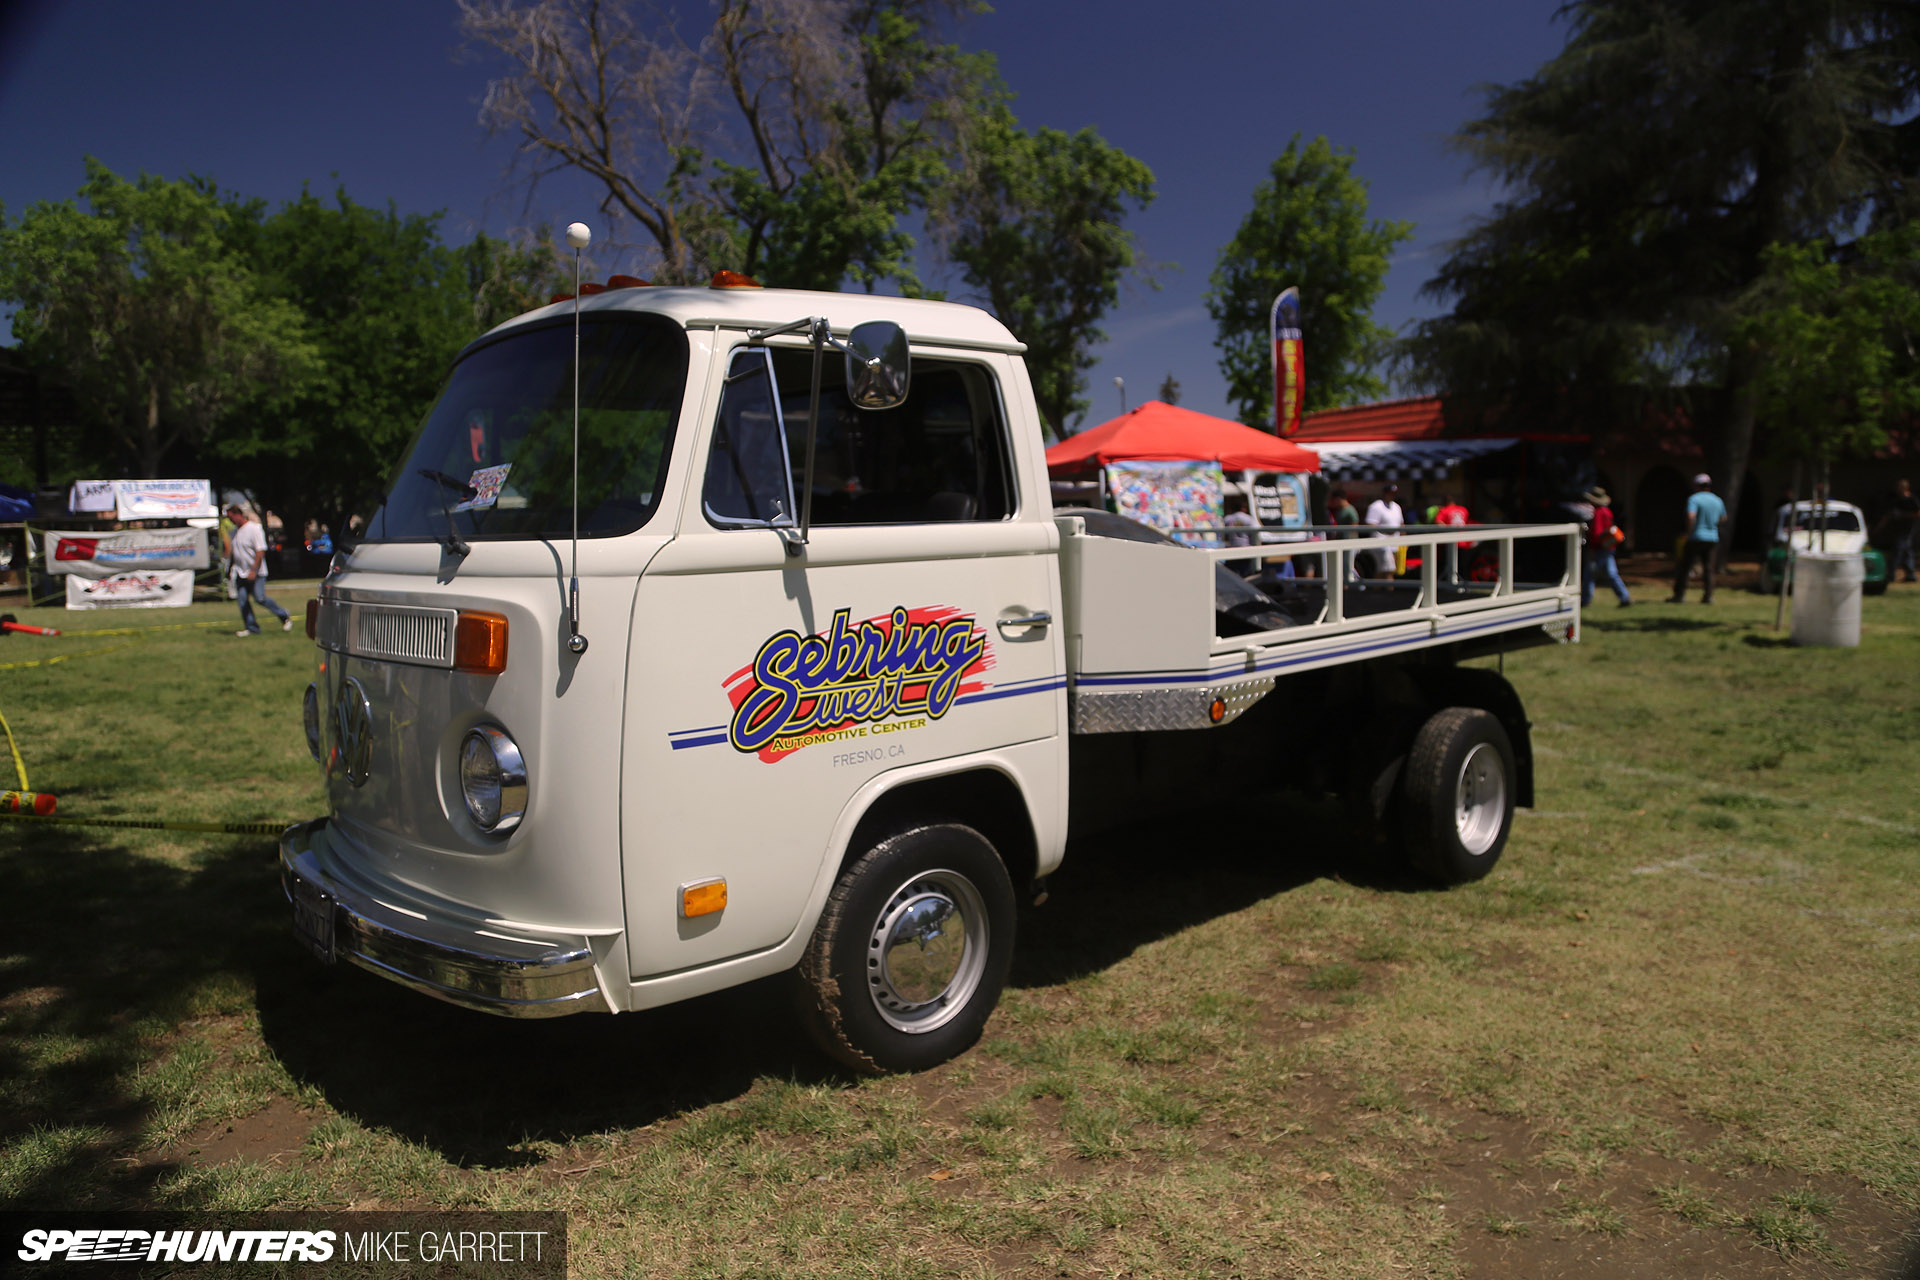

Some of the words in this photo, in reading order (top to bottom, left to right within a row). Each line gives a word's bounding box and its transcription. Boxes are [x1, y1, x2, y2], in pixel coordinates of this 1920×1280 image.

[732, 606, 986, 753] Sebring
[814, 671, 905, 726] west
[888, 744, 905, 758] CA
[225, 823, 292, 834] CAUTIO
